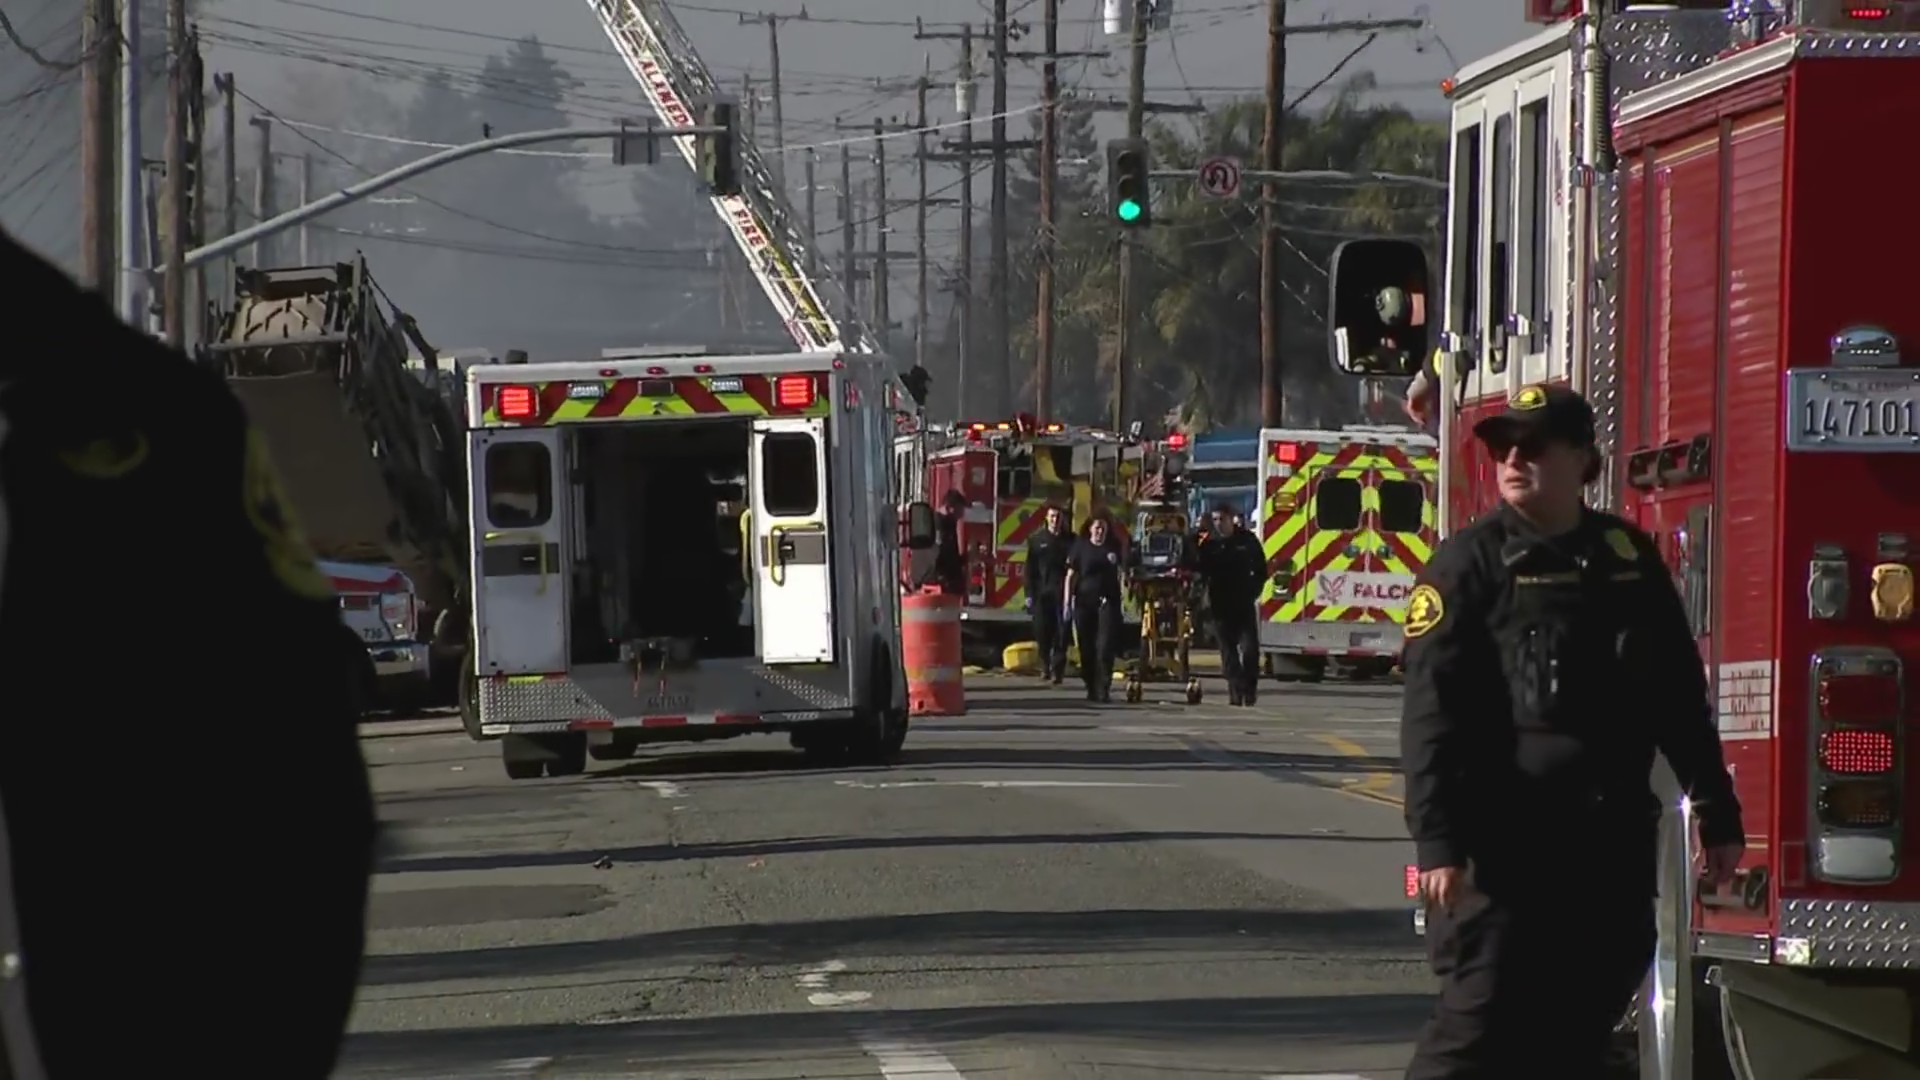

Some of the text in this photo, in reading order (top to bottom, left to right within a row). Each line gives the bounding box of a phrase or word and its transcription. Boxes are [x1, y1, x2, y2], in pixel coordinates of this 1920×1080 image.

[639, 60, 690, 125] ALAMED
[733, 208, 766, 247] FIRE
[1802, 398, 1920, 437] 147101
